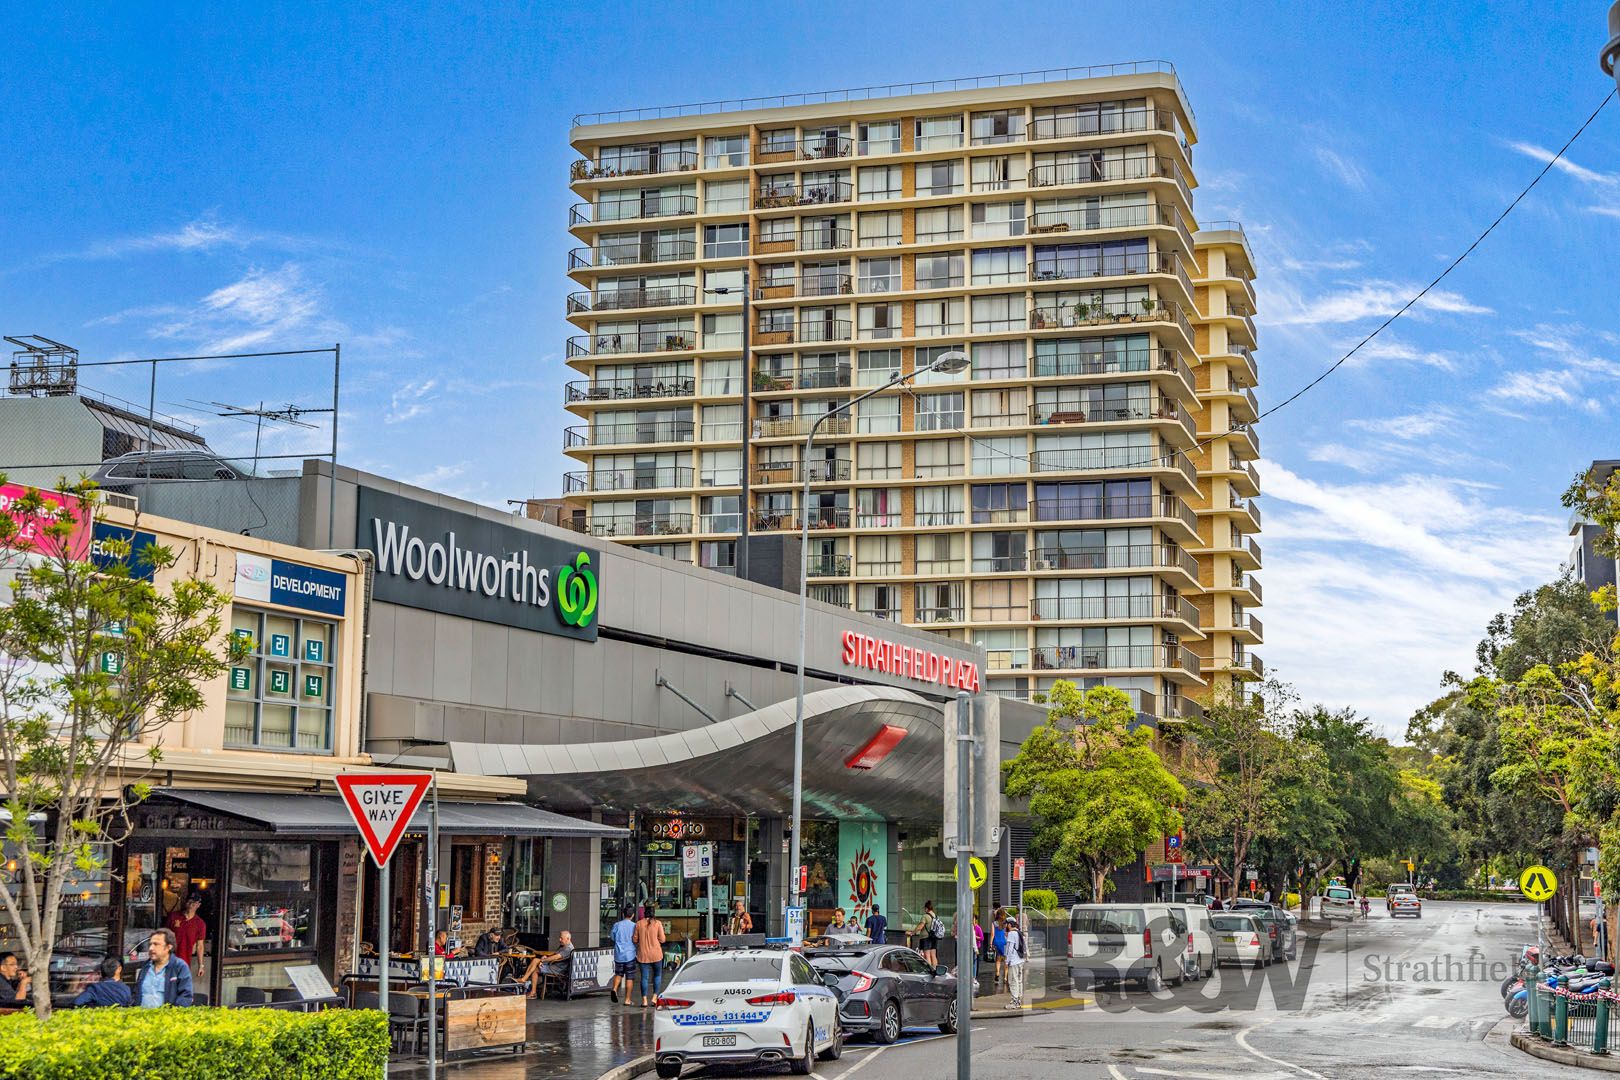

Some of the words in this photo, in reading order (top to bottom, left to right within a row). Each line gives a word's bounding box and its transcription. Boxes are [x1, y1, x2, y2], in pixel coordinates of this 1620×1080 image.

[373, 517, 550, 607] Woolworths
[273, 574, 342, 601] DEVELOPMENT
[842, 630, 938, 682] STRATHFIELD
[939, 655, 980, 693] PLAZA
[362, 790, 403, 805] GIVE
[368, 809, 397, 821] WAY
[685, 1014, 718, 1022] Police
[723, 1012, 738, 1020] 131
[740, 1012, 757, 1020] 444
